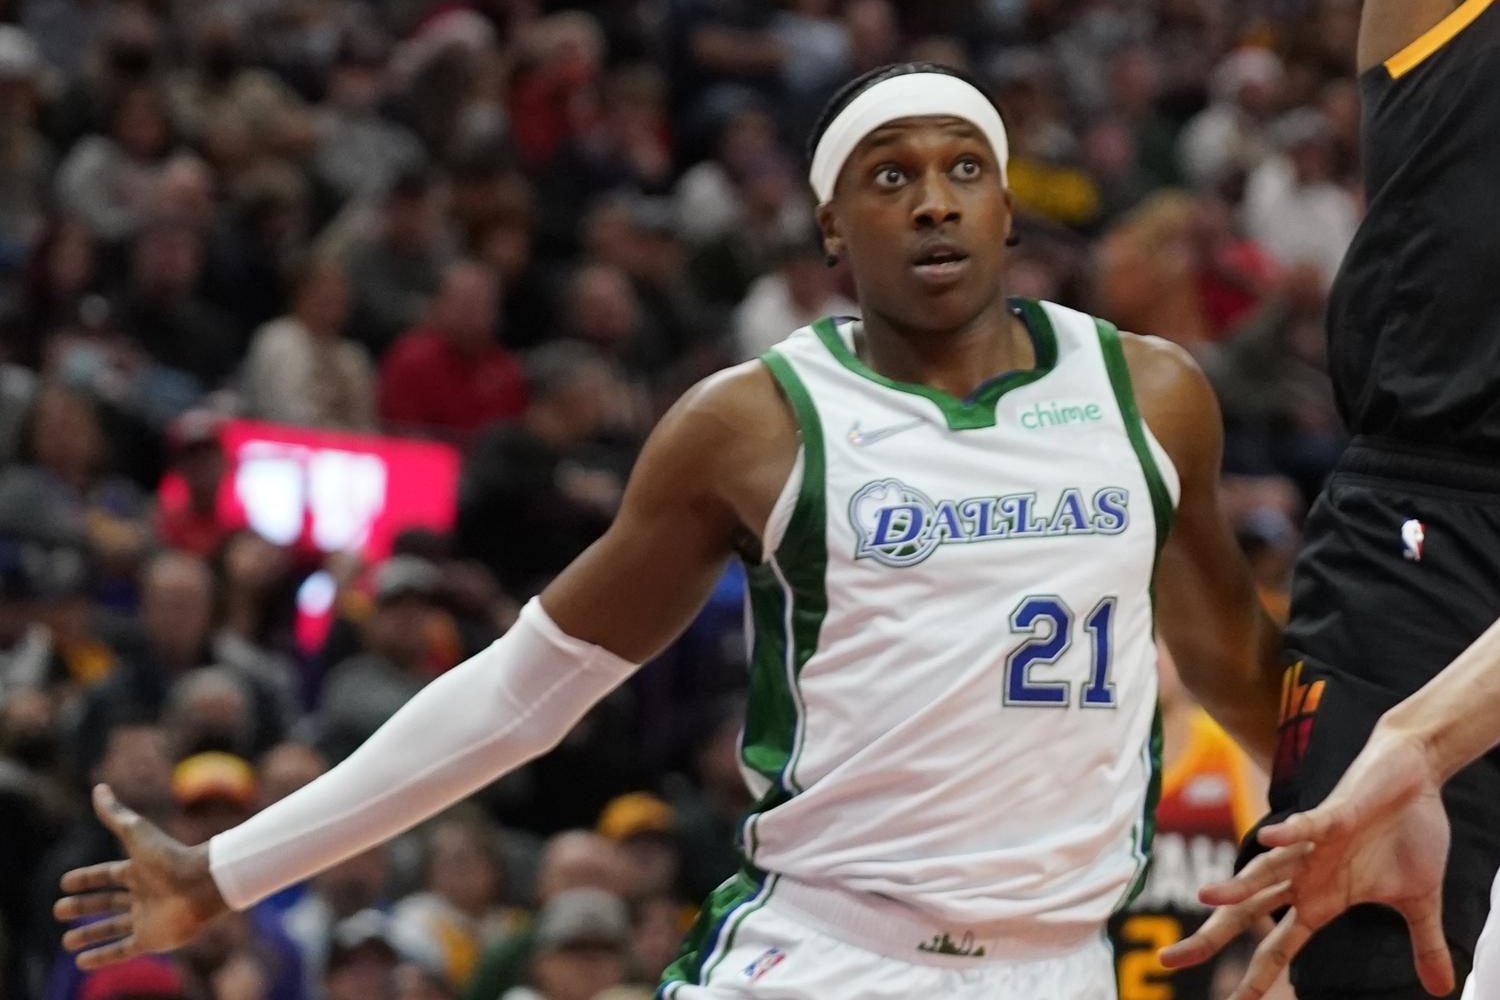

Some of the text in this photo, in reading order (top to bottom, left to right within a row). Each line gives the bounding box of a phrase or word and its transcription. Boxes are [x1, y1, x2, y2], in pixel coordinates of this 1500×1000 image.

[1020, 402, 1104, 430] chime
[857, 486, 1131, 560] DALLAS
[1002, 594, 1119, 709] 21
